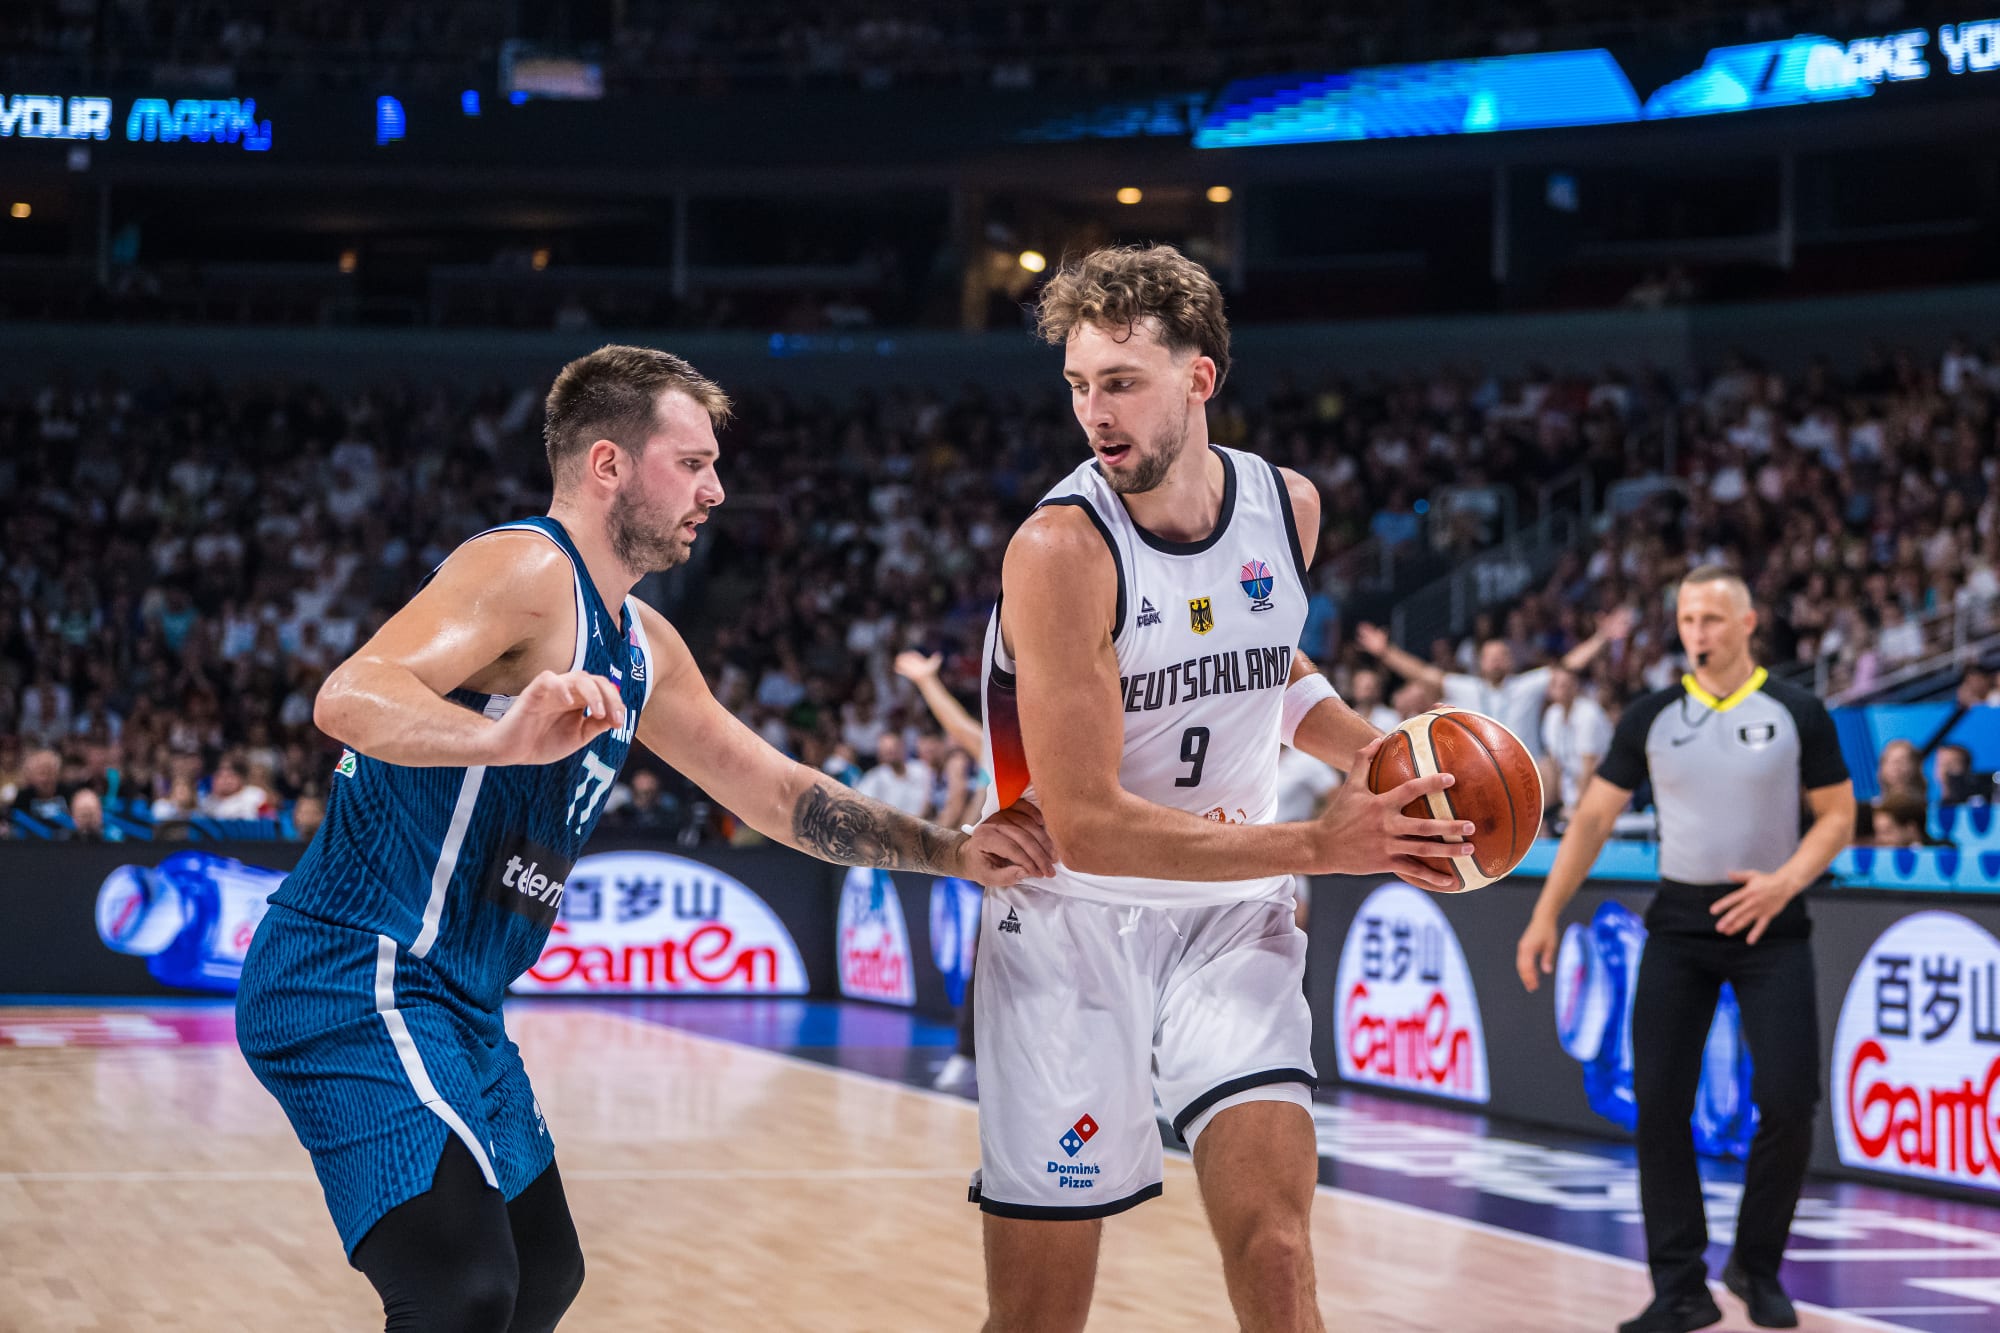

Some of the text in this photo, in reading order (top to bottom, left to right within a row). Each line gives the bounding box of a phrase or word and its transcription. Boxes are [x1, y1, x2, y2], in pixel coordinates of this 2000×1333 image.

[1805, 28, 1930, 91] MAKE
[0, 94, 112, 141] YOUR
[1137, 611, 1162, 628] PEAK
[1250, 598, 1275, 612] 25
[1174, 726, 1210, 788] 9
[566, 750, 616, 835] 77
[998, 919, 1021, 935] PEAK
[1362, 917, 1446, 982] 百岁山
[1875, 954, 2000, 1044] 百岁山
[1059, 1175, 1094, 1188] Pizza
